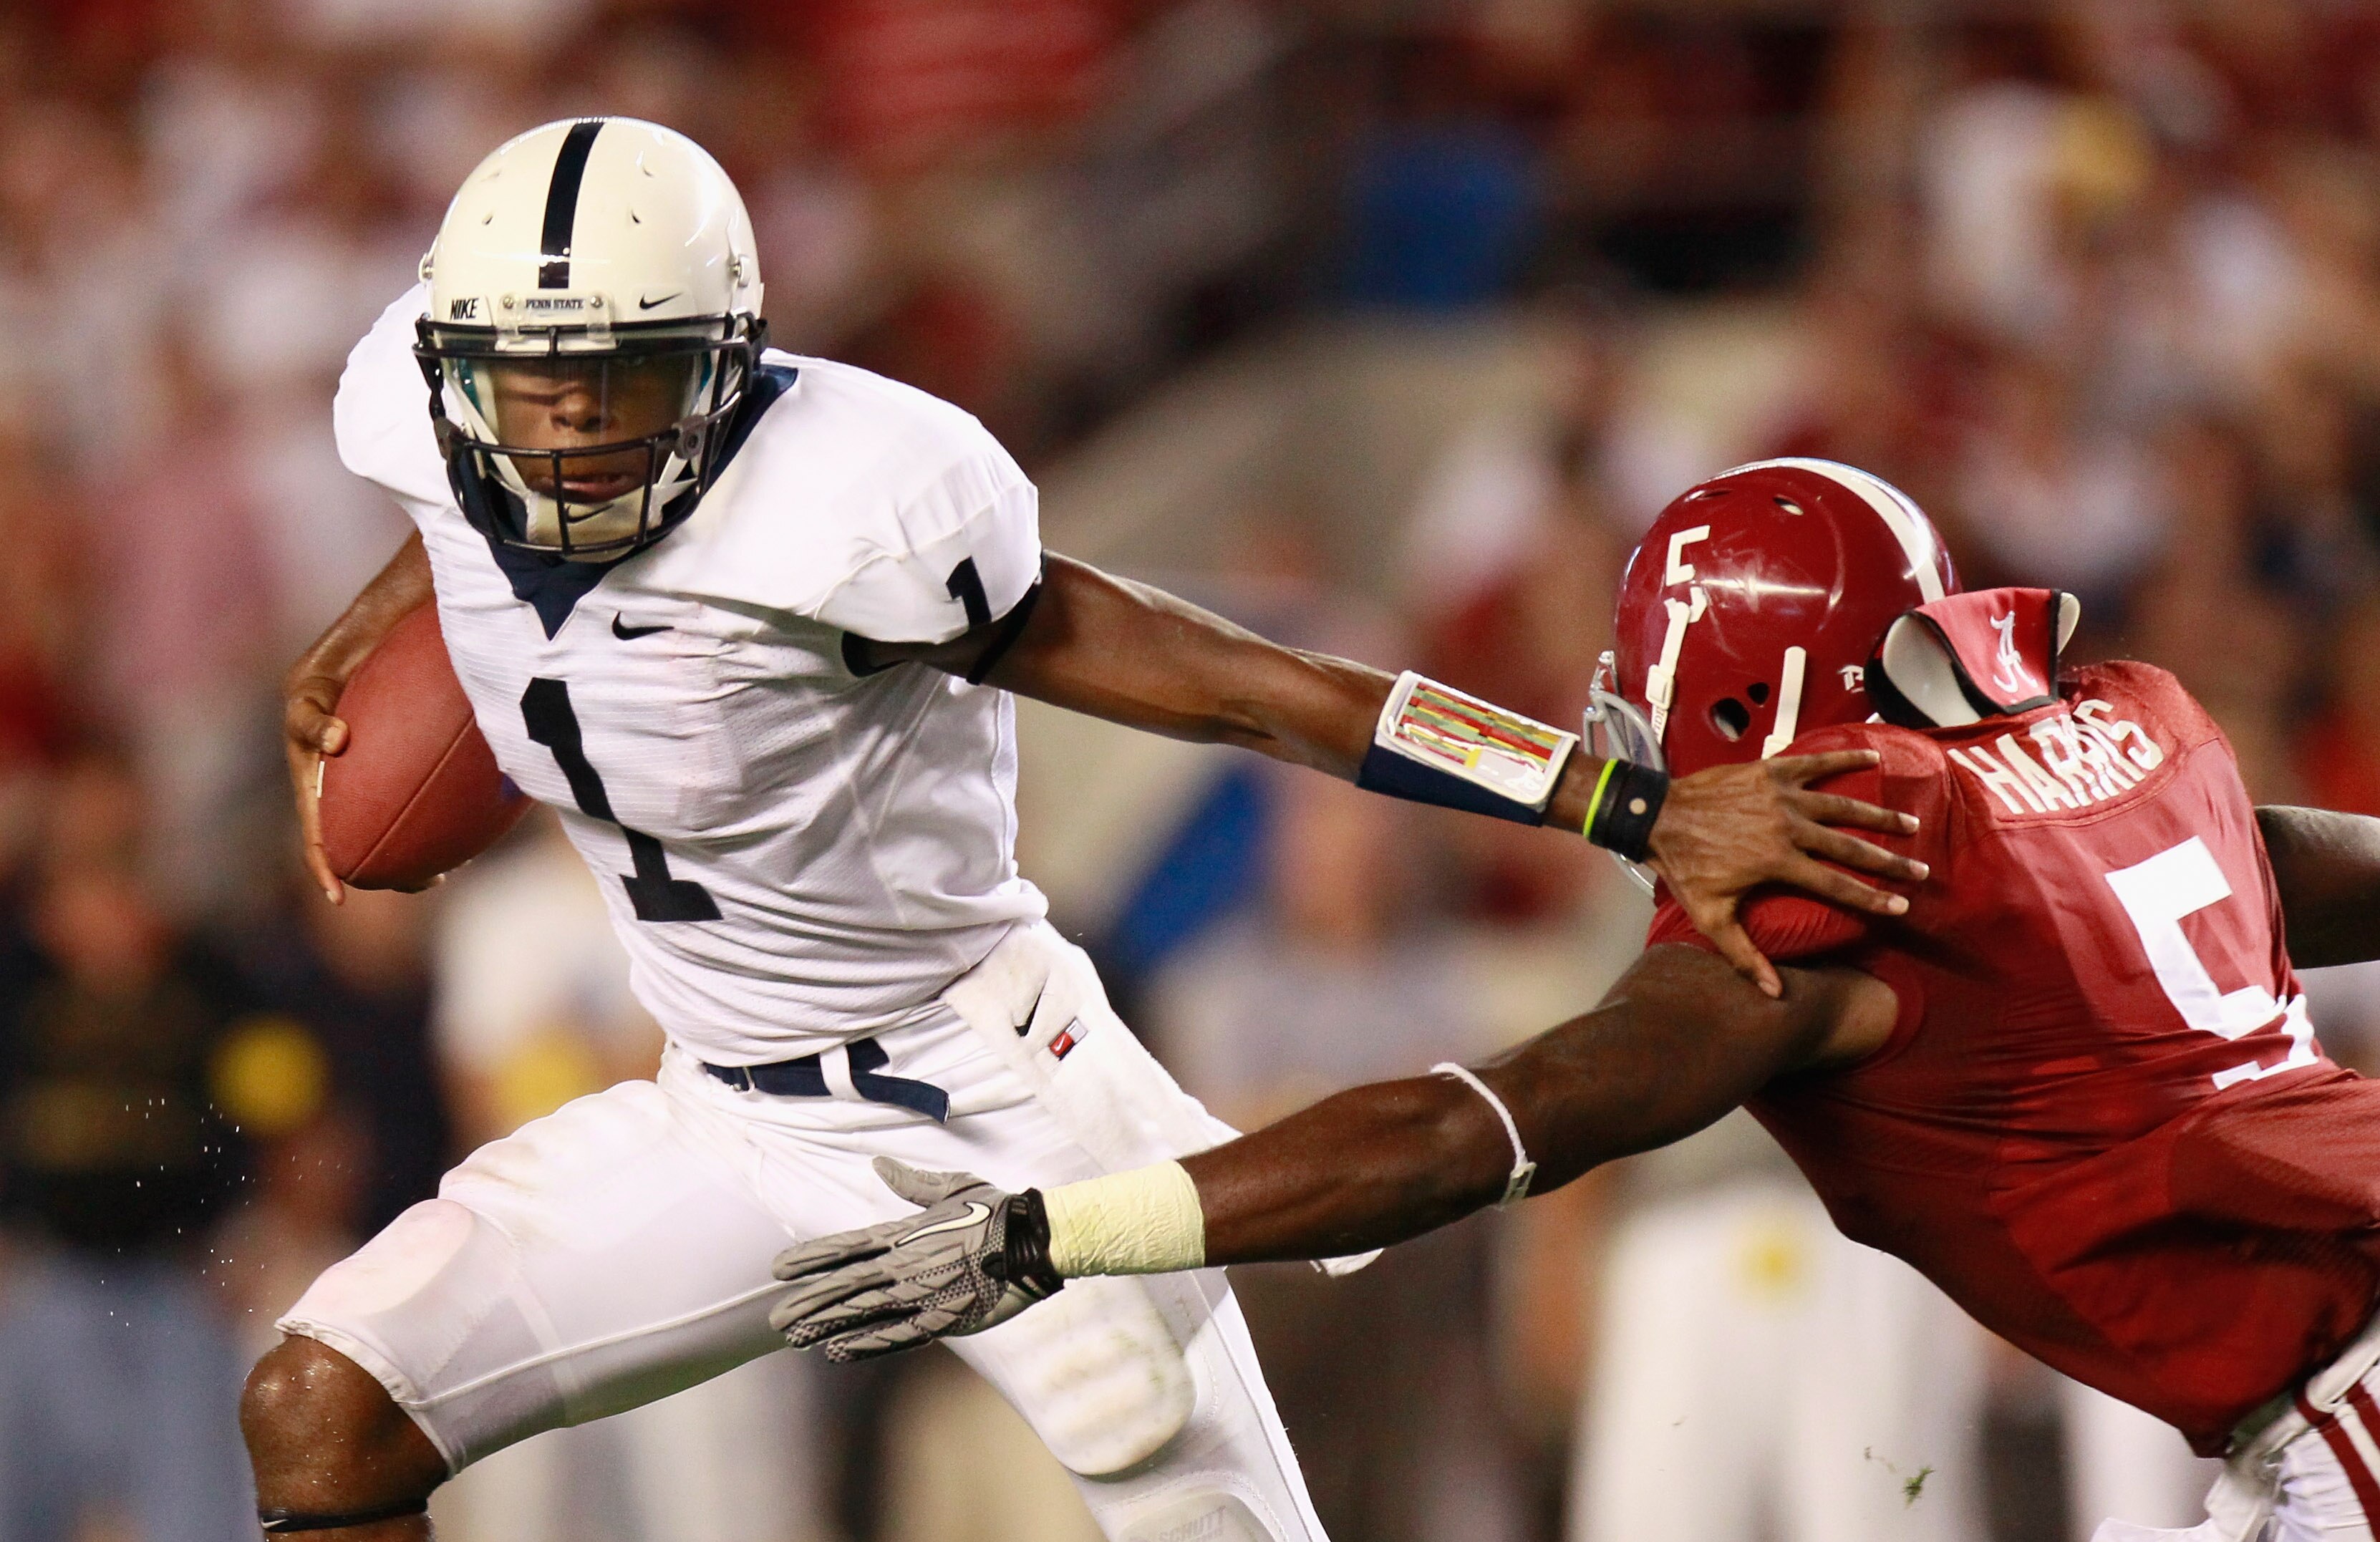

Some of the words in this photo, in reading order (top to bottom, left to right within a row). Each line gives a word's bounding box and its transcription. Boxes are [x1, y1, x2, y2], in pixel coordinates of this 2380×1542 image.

[450, 297, 479, 320] NIKE
[526, 298, 551, 309] PENN
[553, 298, 584, 309] STATE
[945, 556, 992, 631] 1
[1663, 525, 1711, 624] 5
[520, 677, 724, 921] 1
[1946, 698, 2164, 815] HARRIS
[2104, 835, 2319, 1090] 5
